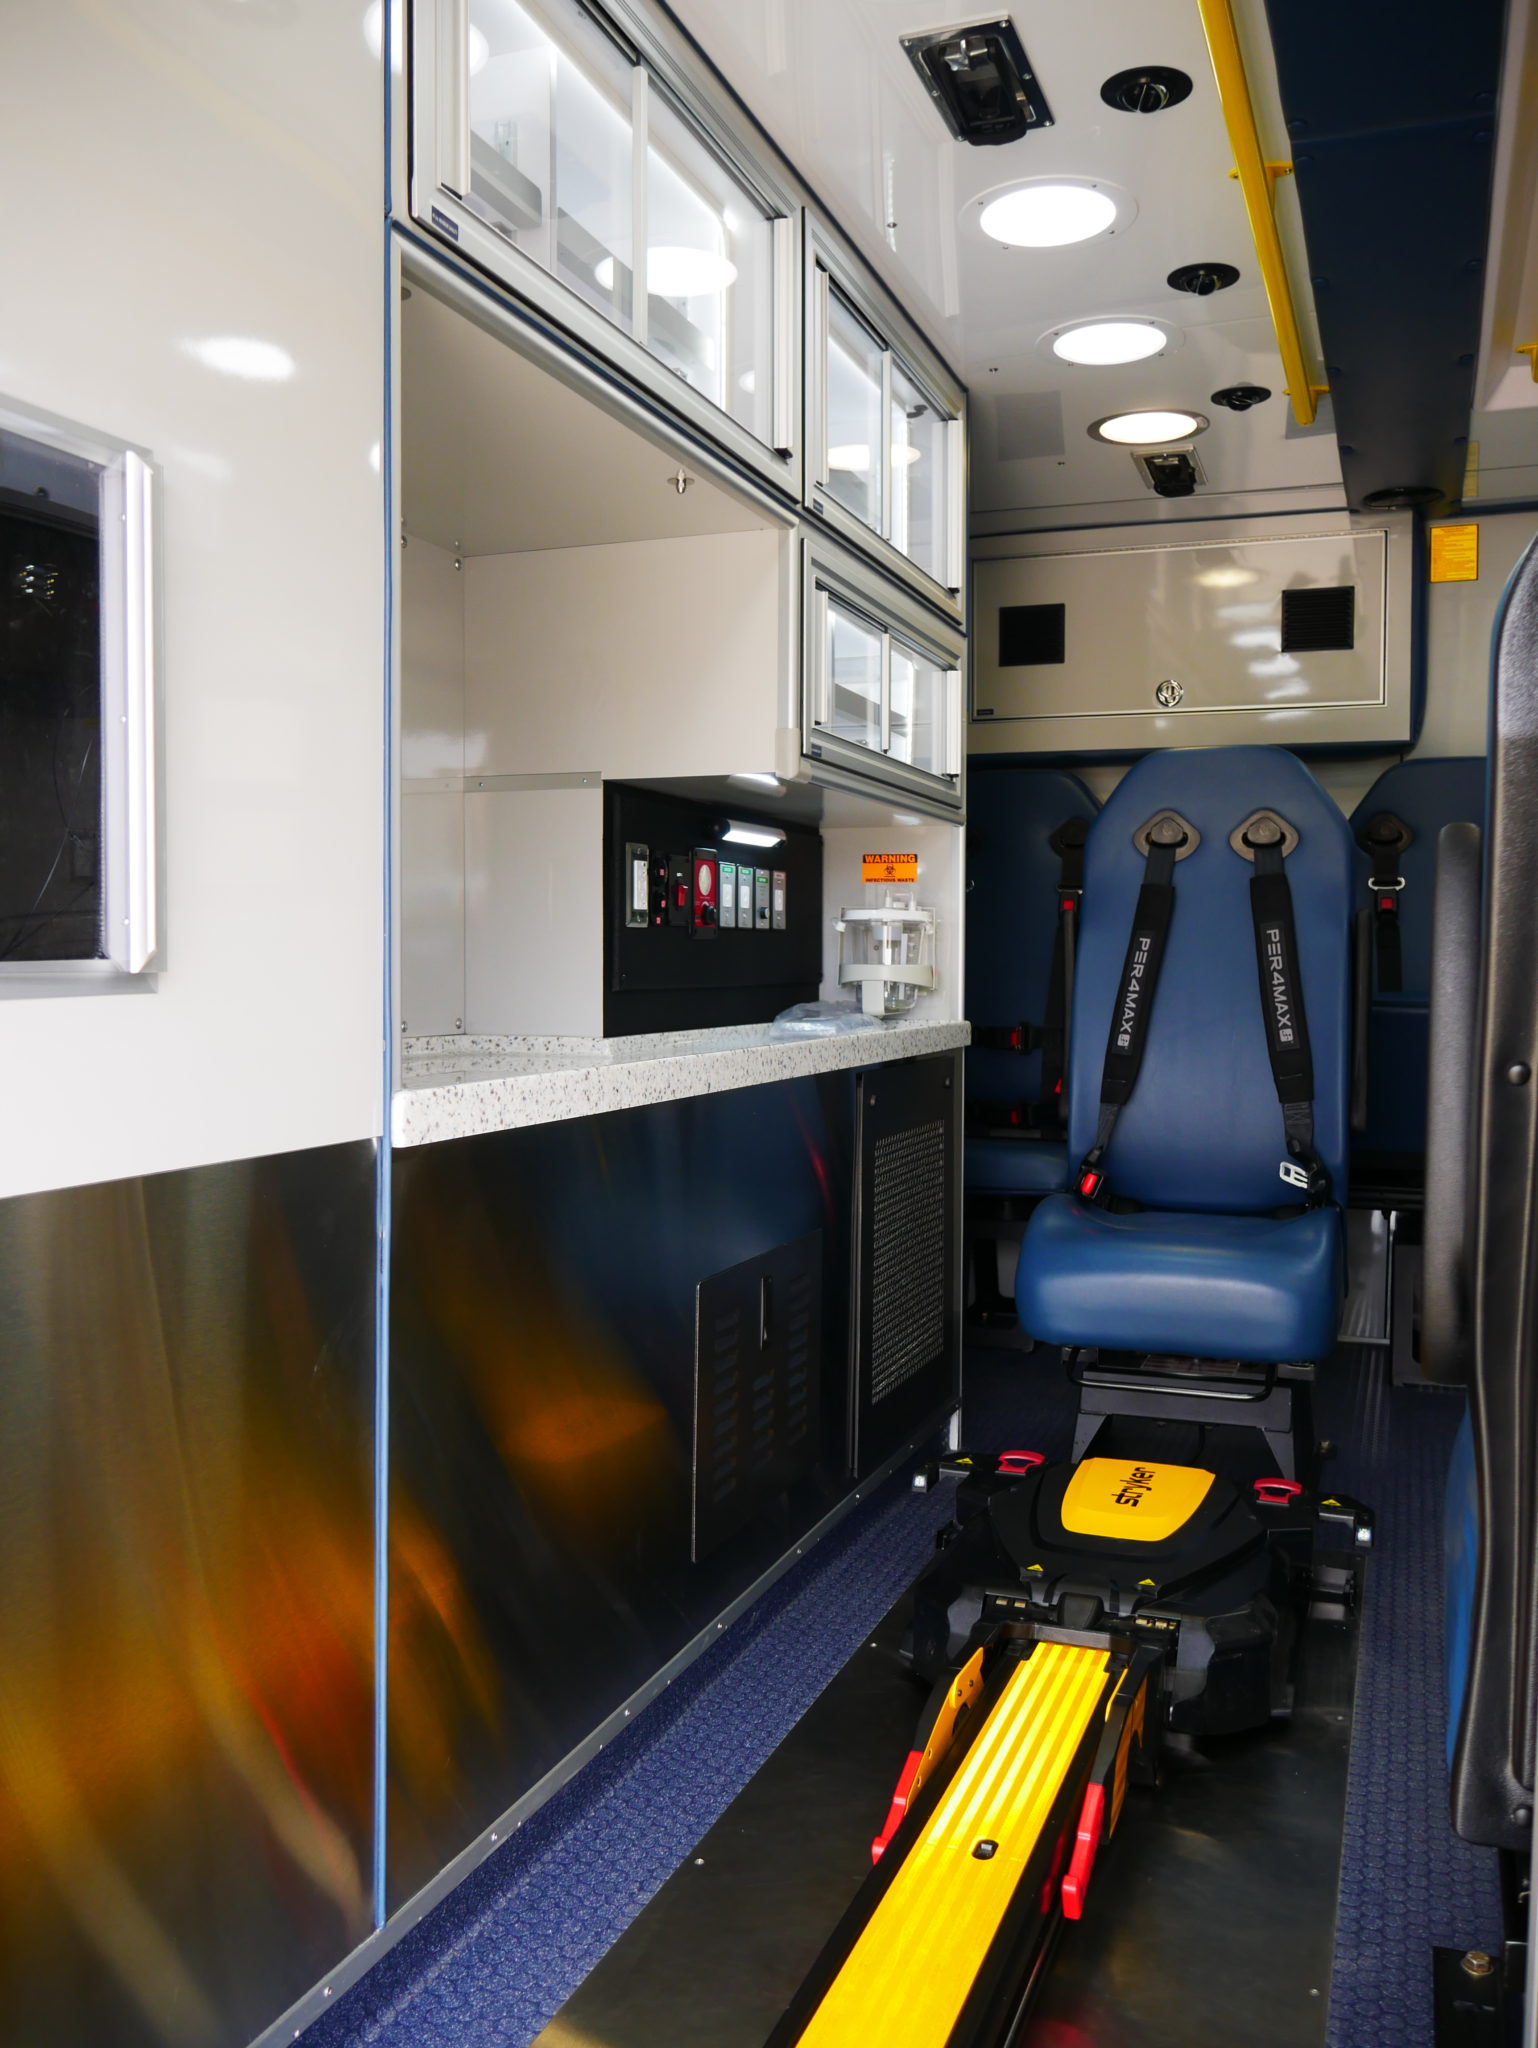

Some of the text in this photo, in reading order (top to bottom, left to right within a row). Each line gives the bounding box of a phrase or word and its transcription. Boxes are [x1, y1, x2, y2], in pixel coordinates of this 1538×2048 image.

[864, 854, 916, 863] WARNING
[1120, 937, 1151, 1033] PER4MAX
[1266, 928, 1292, 1028] PER4MAX
[1111, 1466, 1156, 1507] stryker
